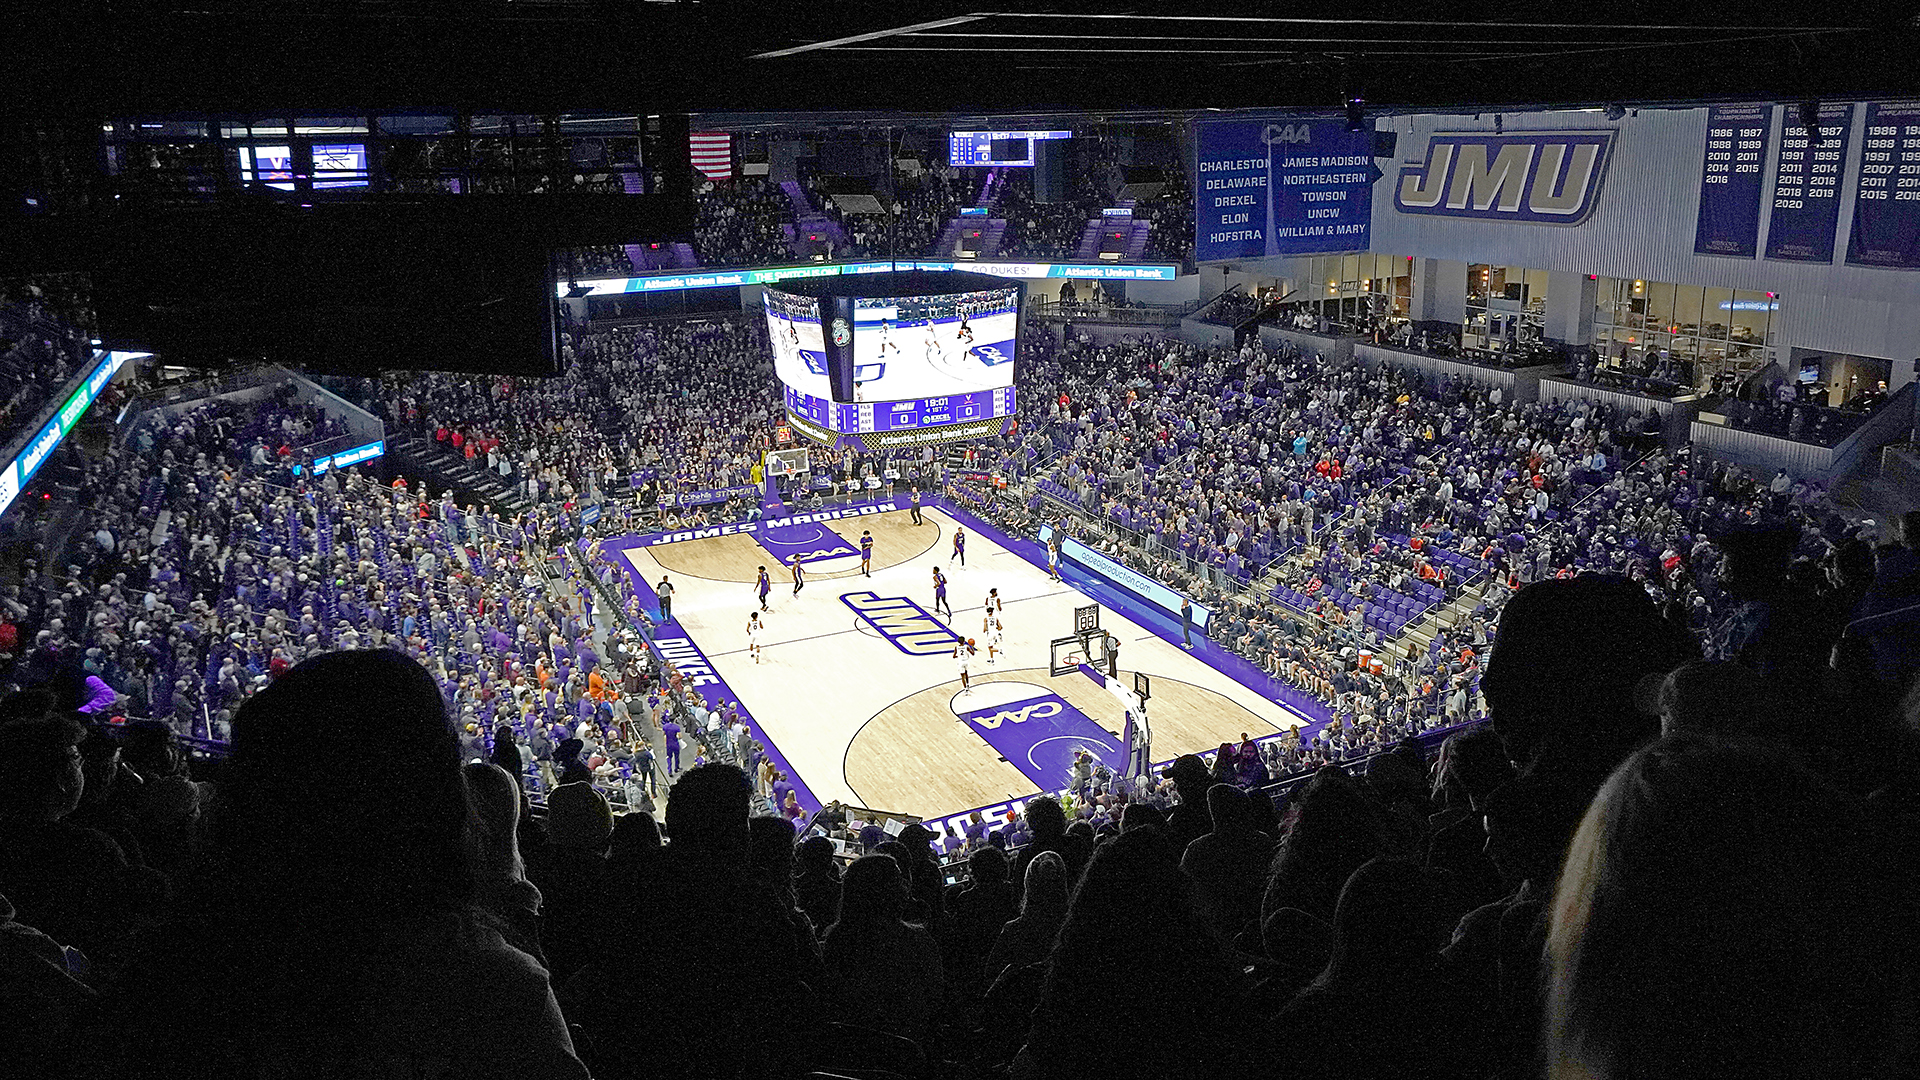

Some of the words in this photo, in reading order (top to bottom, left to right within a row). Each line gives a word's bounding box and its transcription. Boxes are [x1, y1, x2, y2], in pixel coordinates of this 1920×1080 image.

[1260, 124, 1310, 144] CAA
[1710, 128, 1733, 137] 1986
[1739, 128, 1763, 137] 1987
[1868, 126, 1897, 136] 1986
[1708, 140, 1732, 149] 1988
[1738, 140, 1762, 149] 1989
[1783, 139, 1808, 148] 1988
[1867, 139, 1895, 148] 1988
[1708, 152, 1731, 161] 2010
[1736, 152, 1758, 161] 2011
[1782, 151, 1804, 160] 1991
[1814, 152, 1840, 160] 1995
[1864, 152, 1891, 162] 1991
[1200, 158, 1271, 172] CHARLESTON
[1282, 157, 1319, 168] JAMES
[1320, 156, 1369, 167] MADISON
[1707, 164, 1729, 172] 2014
[1736, 164, 1760, 172] 2015
[1780, 164, 1802, 172] 2011
[1812, 164, 1838, 173] 2014
[1862, 164, 1895, 174] 2007
[1206, 176, 1267, 190] DELAWARE
[1283, 173, 1366, 186] NORTHEASTERN
[1399, 143, 1600, 215] JMU
[1706, 175, 1728, 184] 2016
[1778, 176, 1804, 184] 2015
[1810, 176, 1836, 186] 2016
[1860, 178, 1887, 187] 2011
[1897, 178, 1920, 188] 201
[1302, 190, 1347, 202] TOWSON
[1776, 188, 1802, 196] 2018
[1808, 188, 1834, 198] 2019
[1860, 190, 1888, 200] 2015
[1214, 195, 1257, 208] DREXEL
[1774, 200, 1803, 209] 2020
[1307, 208, 1340, 219] UNCW
[1221, 213, 1249, 225] ELON
[1278, 226, 1324, 238] WILLIAM
[1326, 225, 1334, 236] &
[1336, 224, 1366, 234] MARY
[1210, 230, 1262, 243] HOFSTRA
[971, 266, 988, 274] GO
[990, 266, 1030, 276] DUKES!
[1064, 267, 1102, 278] Atlantic
[1105, 268, 1134, 278] Union
[1136, 268, 1163, 278] Bank
[644, 278, 685, 290] Atlantic
[685, 277, 716, 287] Union
[716, 274, 743, 284] Bank
[754, 272, 774, 282] THE
[892, 402, 916, 412] JMU
[965, 406, 973, 416] 0
[900, 414, 909, 424] 0
[880, 436, 916, 444] Atlantic
[916, 432, 941, 441] Union
[941, 429, 963, 438] Bank
[963, 426, 990, 436] Center
[715, 486, 757, 498] STENT
[652, 522, 758, 545] JAMES
[766, 503, 898, 529] MADISON
[785, 546, 854, 562] CAA
[842, 592, 972, 654] JMU
[652, 638, 720, 687] DUKES
[971, 701, 1063, 730] CAA
